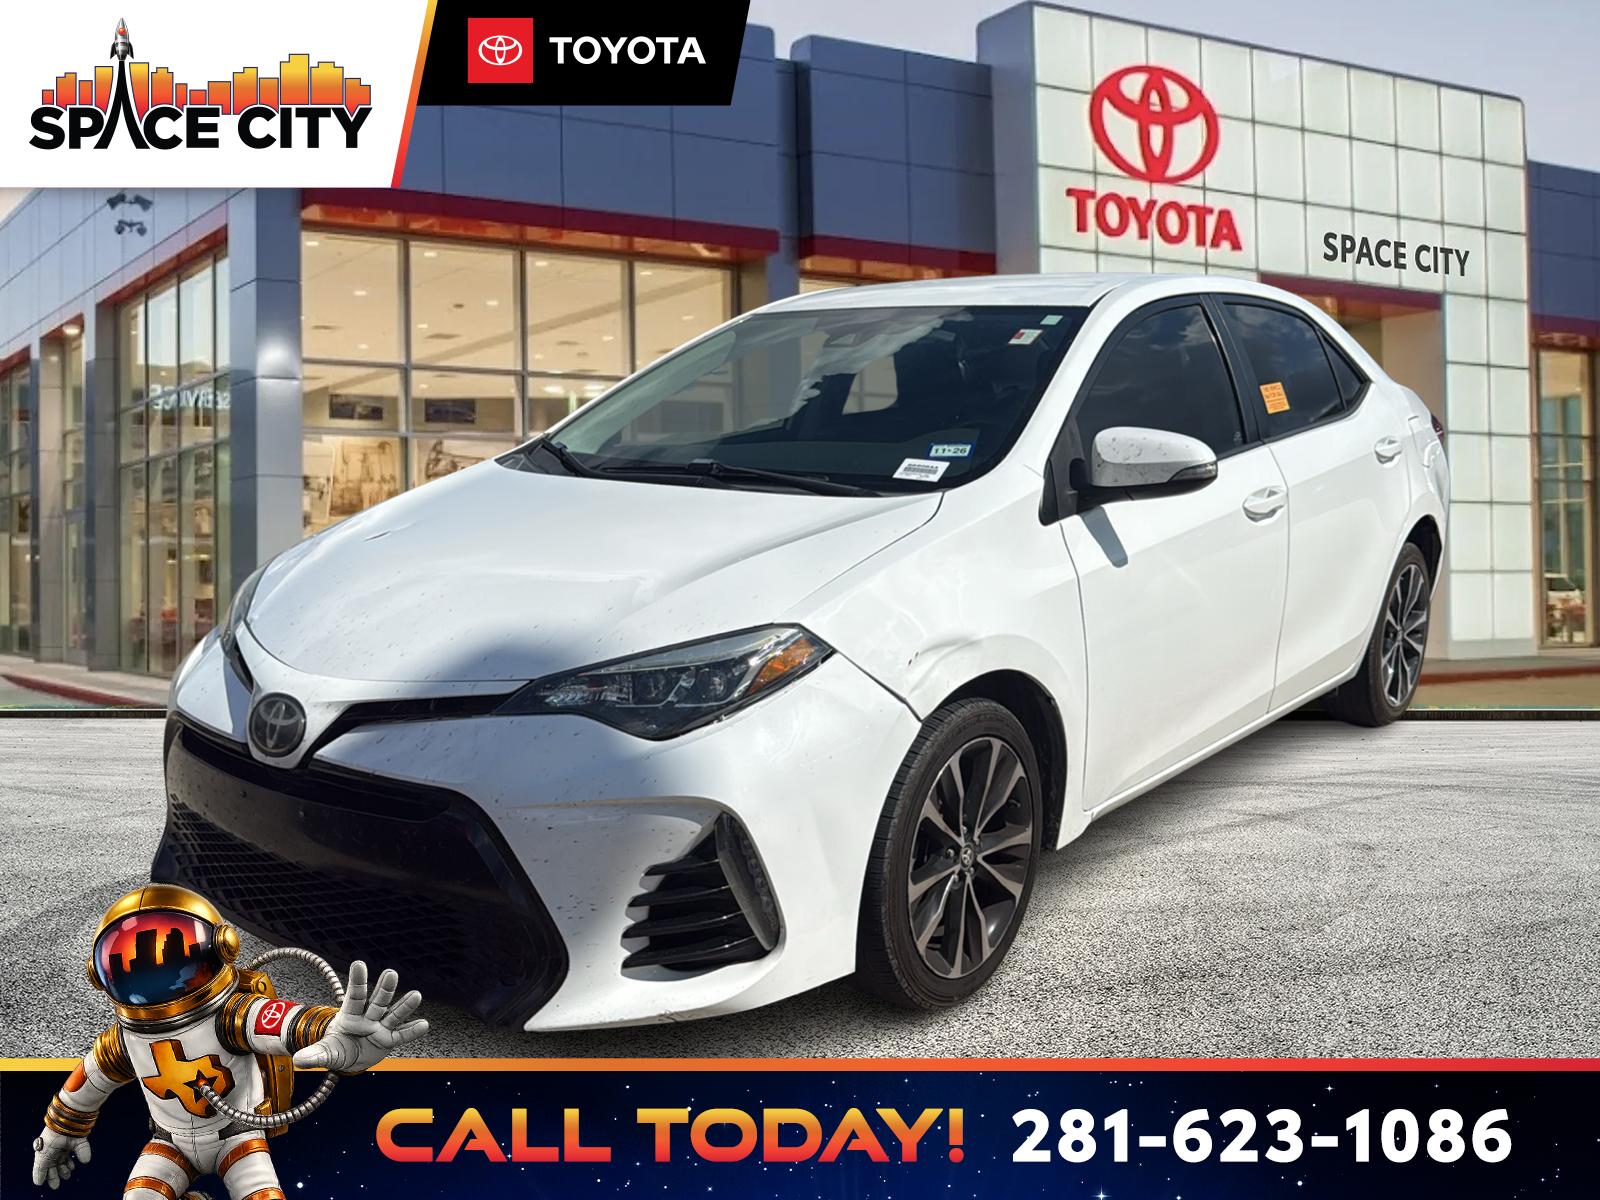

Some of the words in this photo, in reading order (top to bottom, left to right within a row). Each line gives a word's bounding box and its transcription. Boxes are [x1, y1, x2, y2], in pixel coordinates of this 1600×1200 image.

[1066, 188, 1242, 251] TOYOTA
[1323, 232, 1407, 270] SPACE
[1415, 244, 1470, 277] CITY
